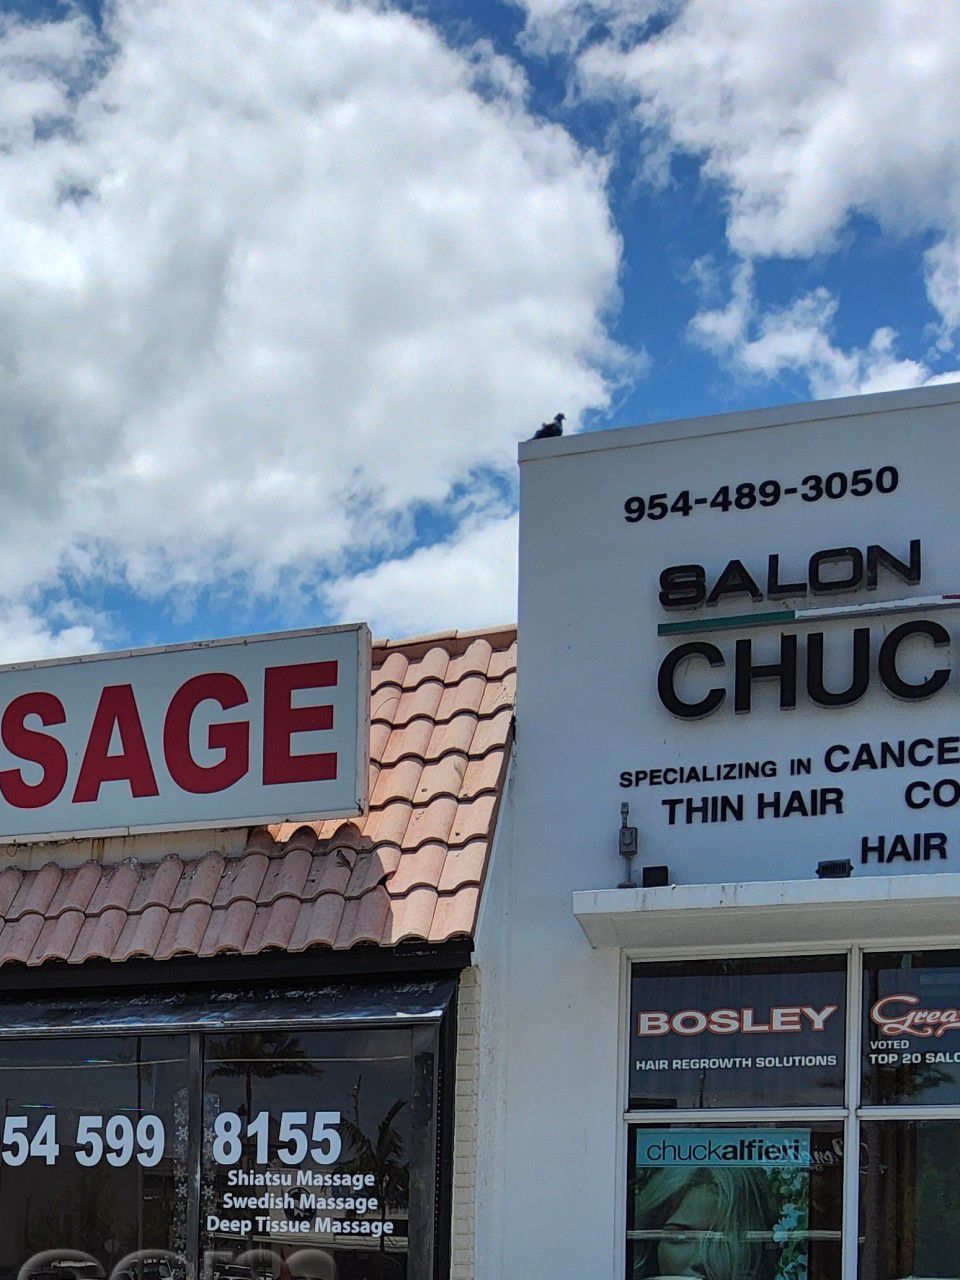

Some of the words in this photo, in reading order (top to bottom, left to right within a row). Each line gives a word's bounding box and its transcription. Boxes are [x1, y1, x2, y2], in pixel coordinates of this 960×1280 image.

[624, 466, 899, 523] 954-489-3050
[658, 539, 921, 611] SALON
[657, 619, 960, 721] CHUC
[619, 760, 777, 788] SPECIALIZING
[790, 757, 811, 776] IN
[662, 795, 743, 825] THIN
[757, 788, 844, 819] HAIR
[861, 832, 948, 864] HAIR
[638, 1003, 839, 1036] BOSLEY
[870, 994, 960, 1038] Grea
[869, 1053, 898, 1064] TOP
[902, 1053, 921, 1063] 20
[870, 1040, 910, 1049] VOTED
[636, 1060, 669, 1070] HAIR
[672, 1058, 752, 1070] REGROWTH
[755, 1055, 837, 1068] SOLUTIONS
[75, 1114, 165, 1167] 599
[212, 1111, 341, 1165] 8155
[647, 1139, 800, 1161] chuckalfieri
[227, 1169, 293, 1187] Shiatsu
[297, 1170, 375, 1190] Massage
[223, 1192, 296, 1211] Swedish
[299, 1194, 378, 1213] Massage
[207, 1216, 252, 1234] Deep
[255, 1215, 310, 1233] Tissue
[314, 1218, 393, 1238] Massage
